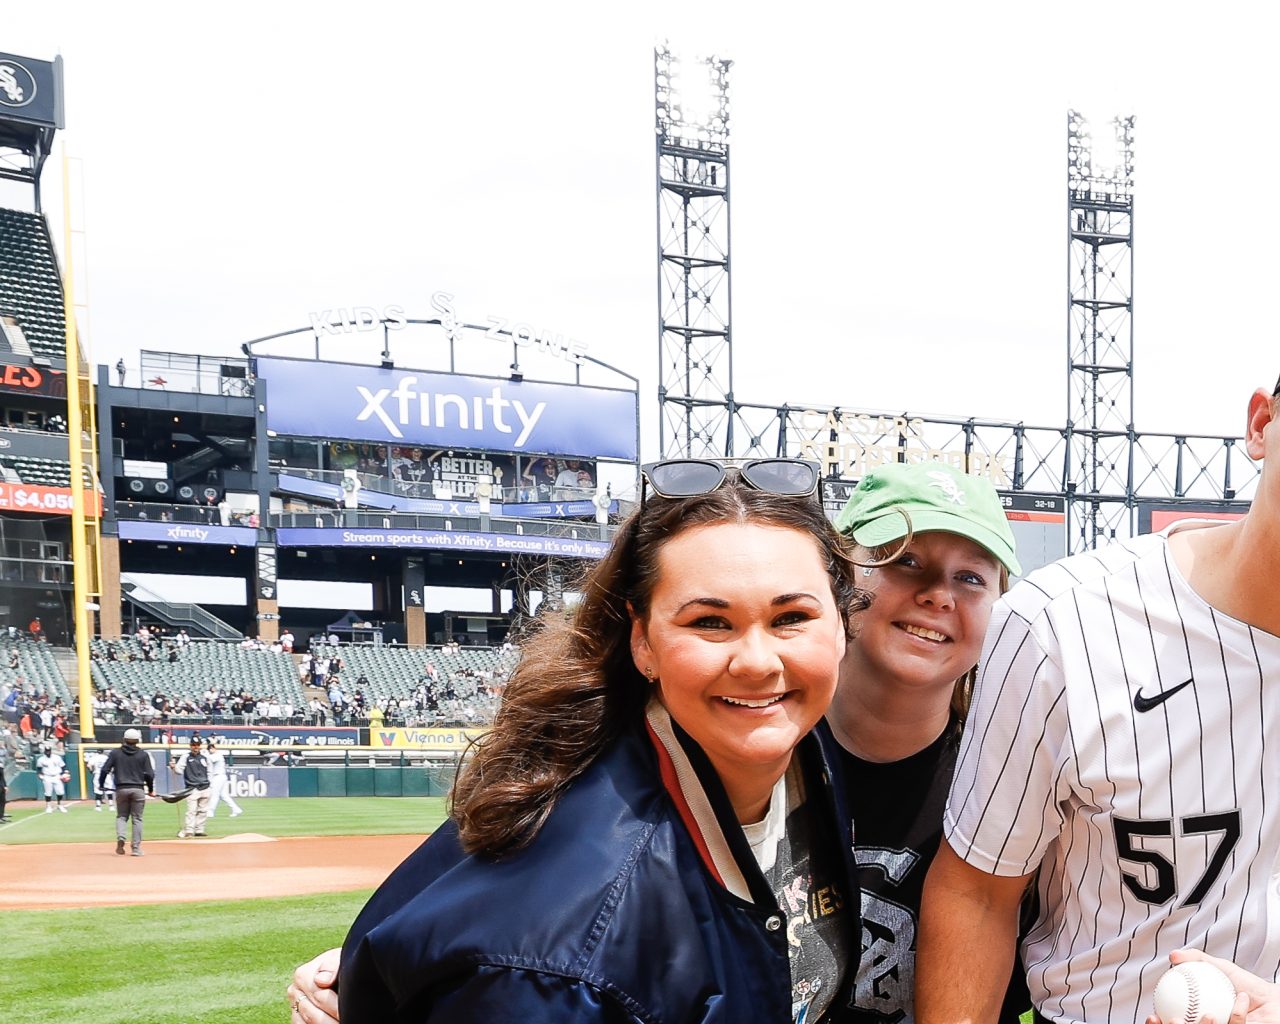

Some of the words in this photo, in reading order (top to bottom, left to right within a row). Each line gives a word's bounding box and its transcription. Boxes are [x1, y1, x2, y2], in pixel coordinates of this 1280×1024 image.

[308, 304, 408, 337] KIDS
[484, 315, 589, 367] ZONE
[0, 364, 43, 389] ES
[355, 376, 547, 448] xfinity
[441, 457, 493, 476] BETTER
[432, 480, 503, 499] BALLPK
[166, 525, 209, 541] xfinity
[343, 531, 385, 542] Stream
[387, 534, 423, 546] sports
[425, 535, 452, 545] with
[496, 538, 543, 550] Because
[544, 540, 560, 552] it's
[561, 543, 582, 555] only
[585, 544, 602, 555] live
[327, 736, 355, 745] Illinois
[404, 730, 455, 743] Vienna
[227, 773, 268, 797] delo
[1112, 808, 1241, 908] 57
